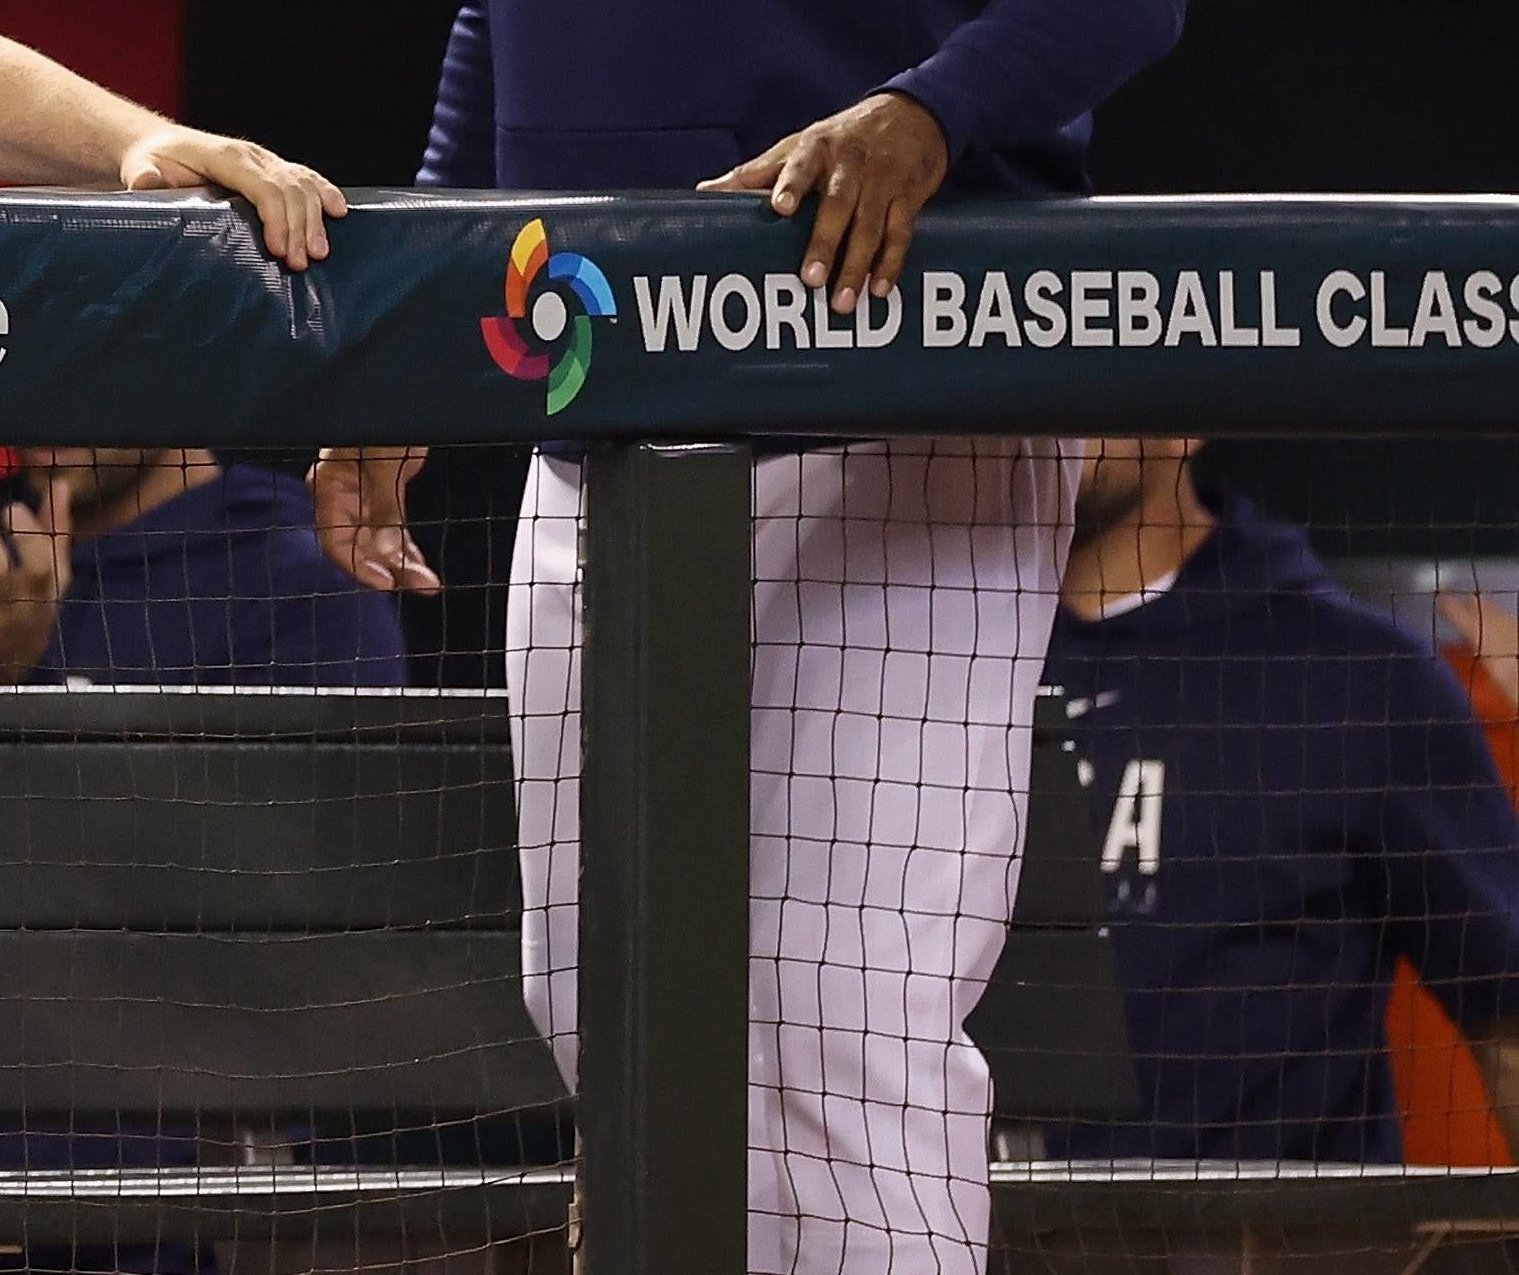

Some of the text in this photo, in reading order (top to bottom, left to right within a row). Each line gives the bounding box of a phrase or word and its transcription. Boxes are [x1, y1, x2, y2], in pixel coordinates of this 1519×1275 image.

[633, 270, 1519, 352] WORLD BASEBALL CLAS
